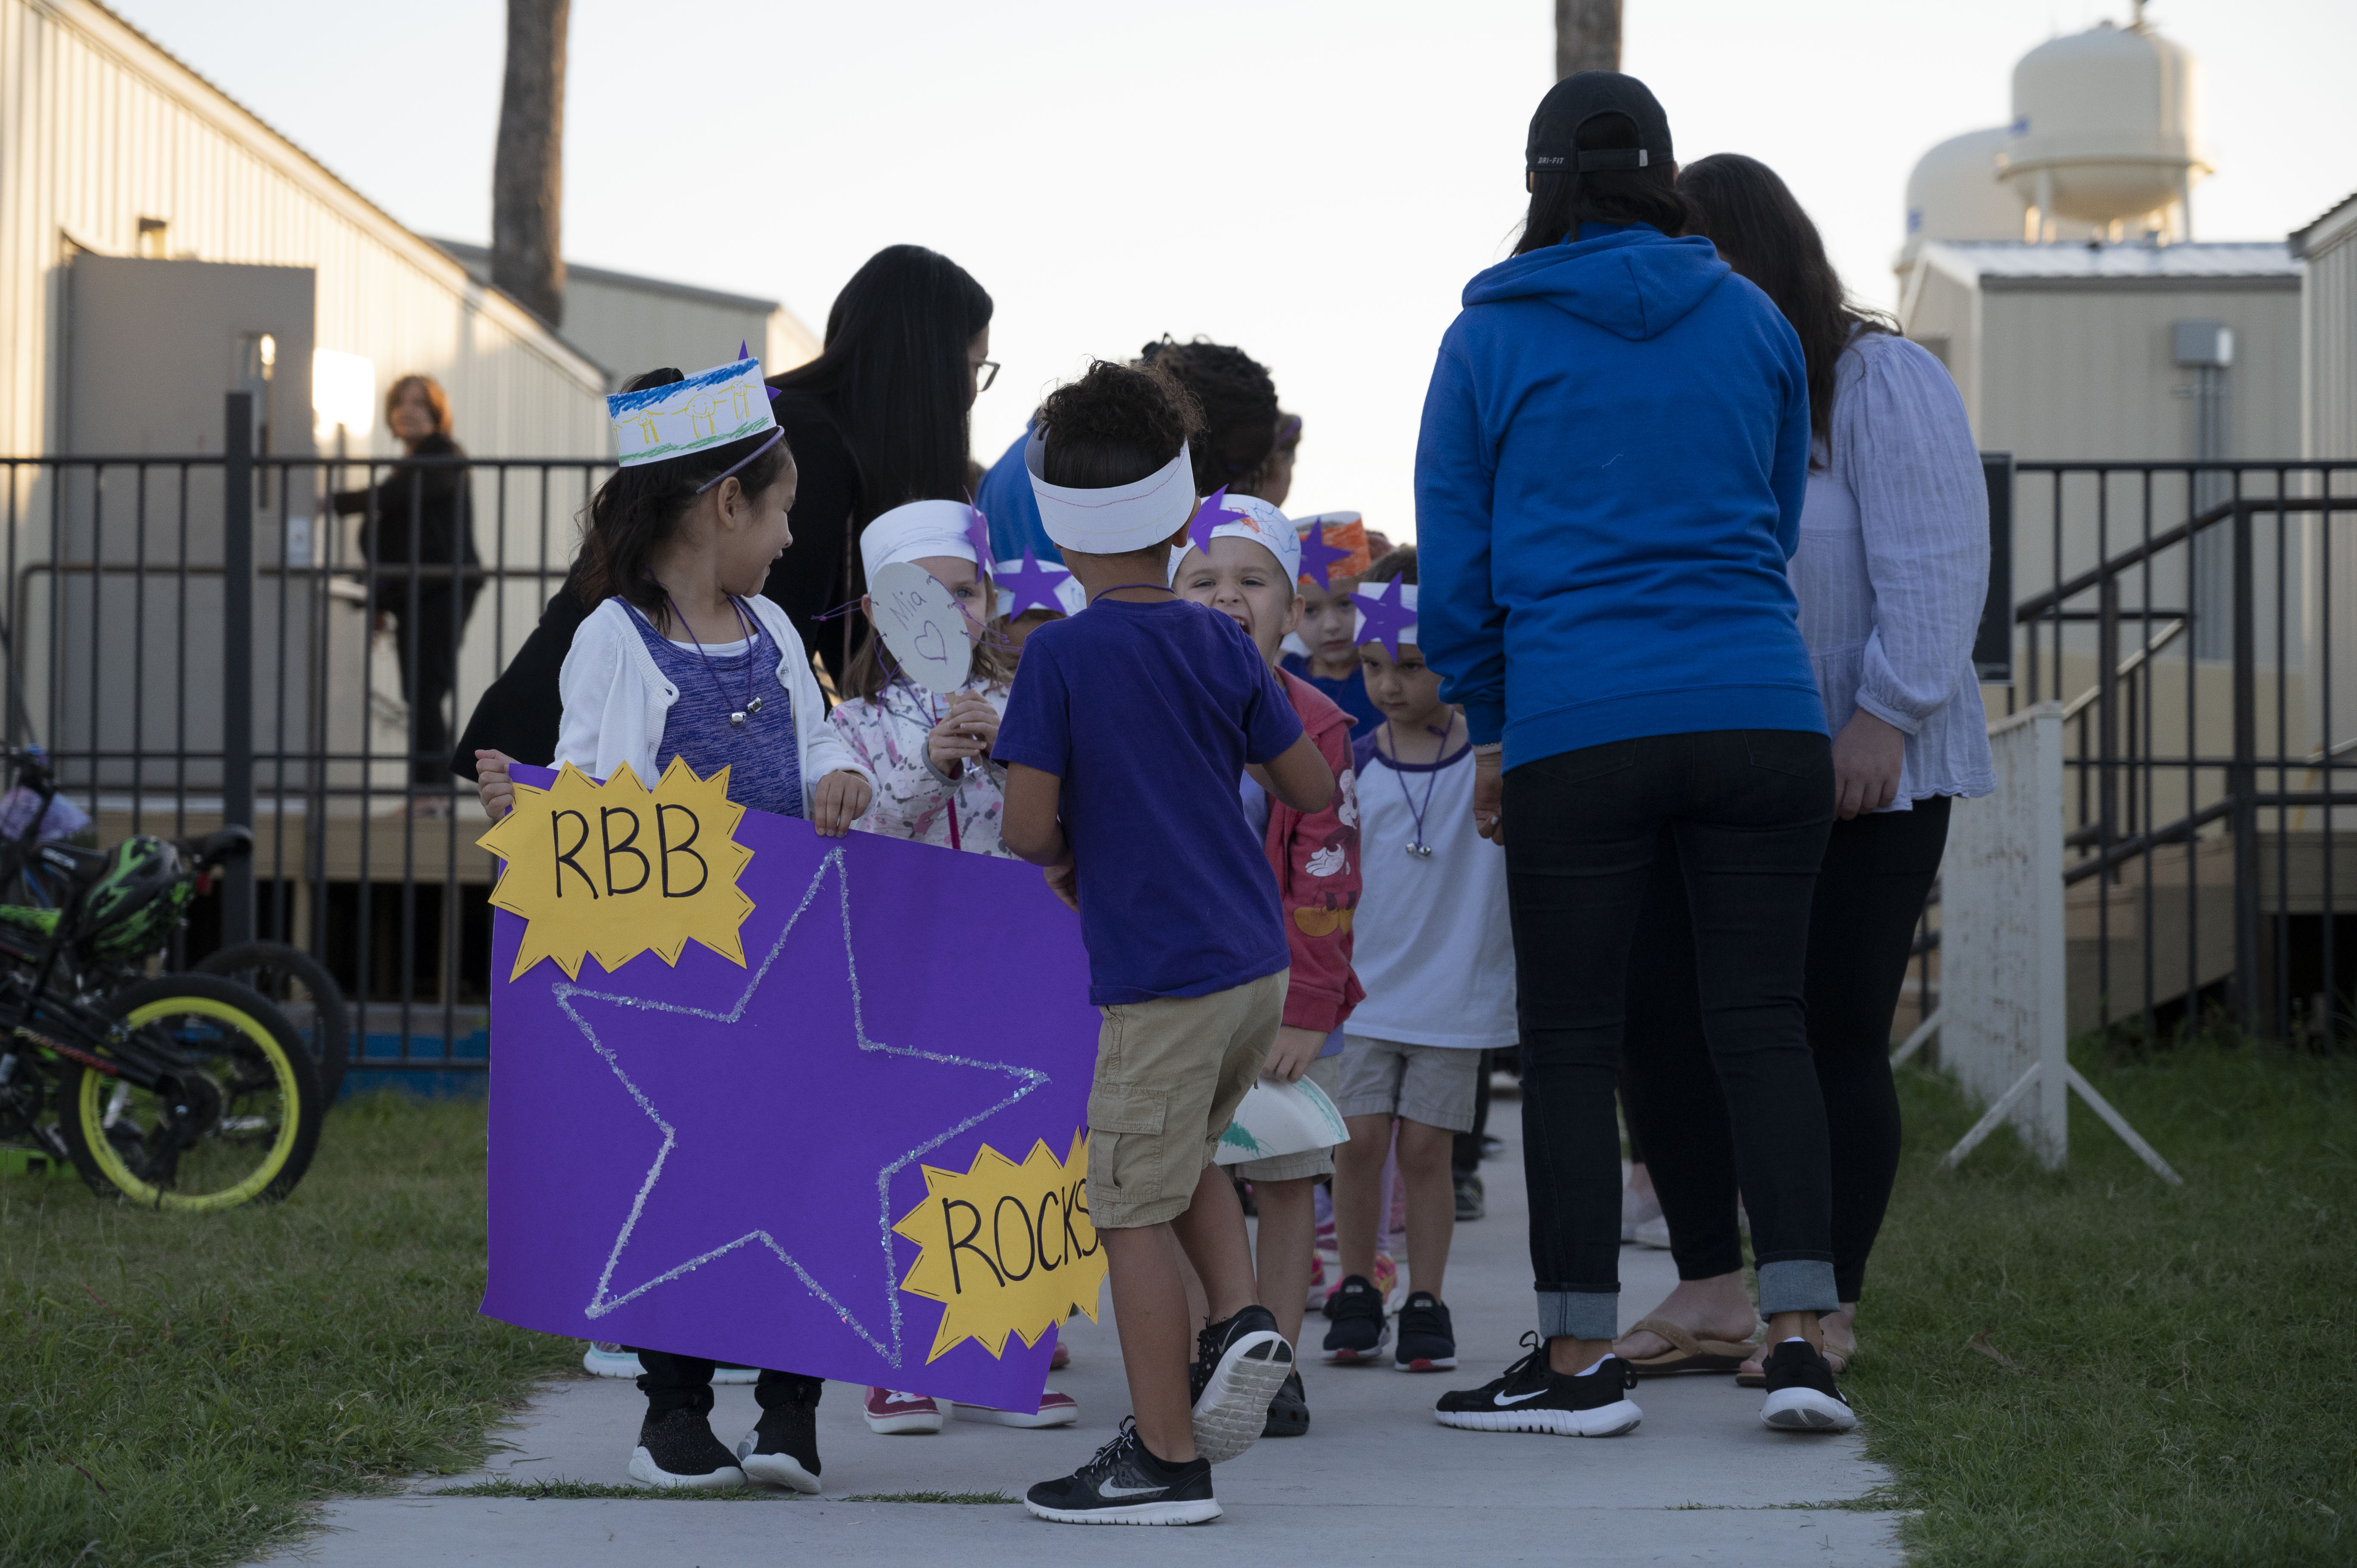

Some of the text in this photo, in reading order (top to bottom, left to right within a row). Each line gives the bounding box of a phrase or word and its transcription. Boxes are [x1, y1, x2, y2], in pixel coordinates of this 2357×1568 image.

[889, 591, 927, 631] Mia
[551, 803, 709, 900] RBB
[942, 1178, 1103, 1295] ROCKS
